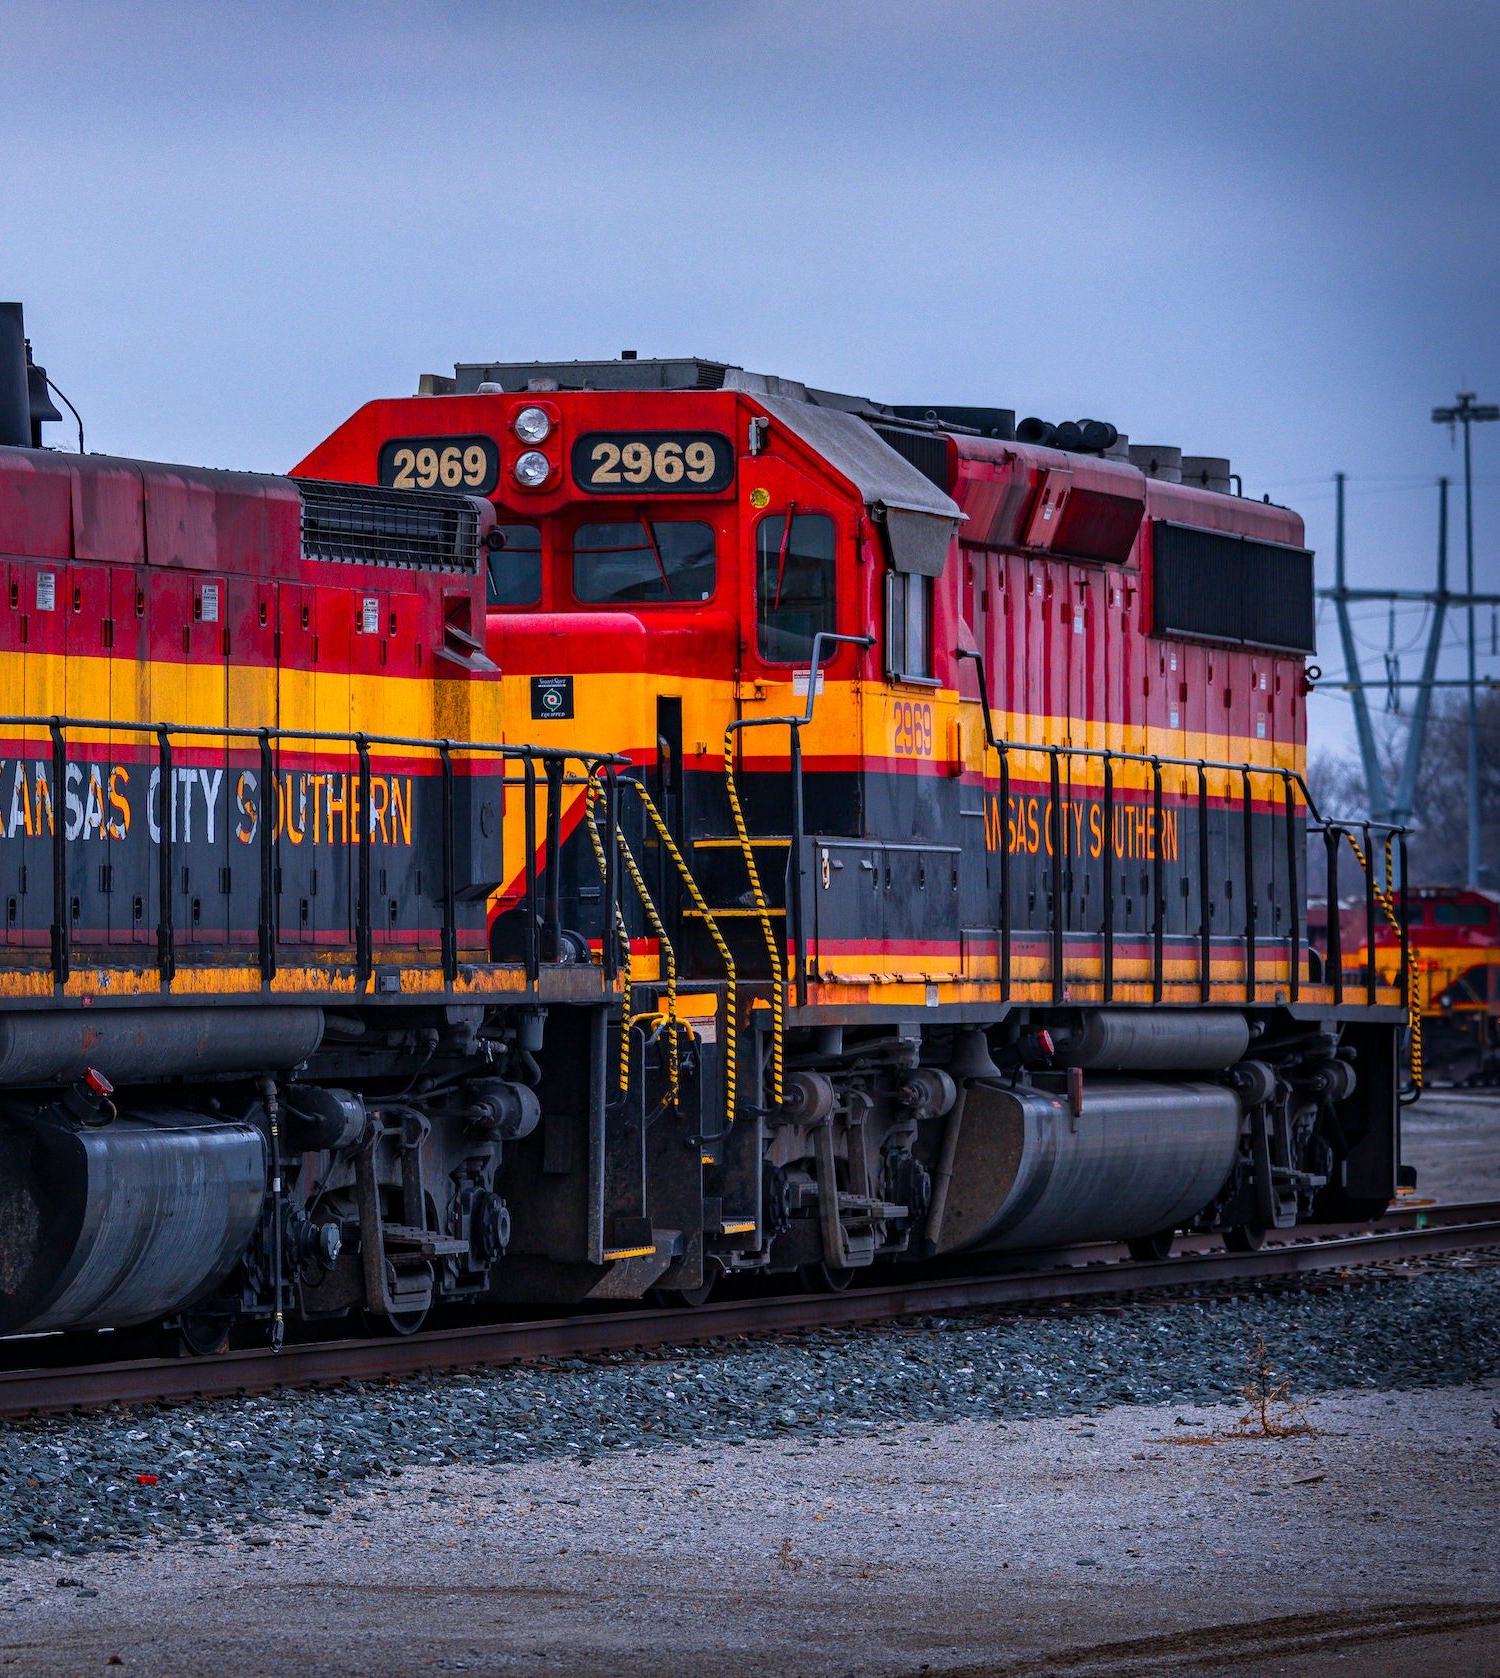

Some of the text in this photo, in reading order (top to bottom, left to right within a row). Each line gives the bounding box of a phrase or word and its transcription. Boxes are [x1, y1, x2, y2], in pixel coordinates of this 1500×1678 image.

[393, 445, 487, 489] 2969
[591, 441, 716, 484] 2969
[894, 701, 932, 756] 2969
